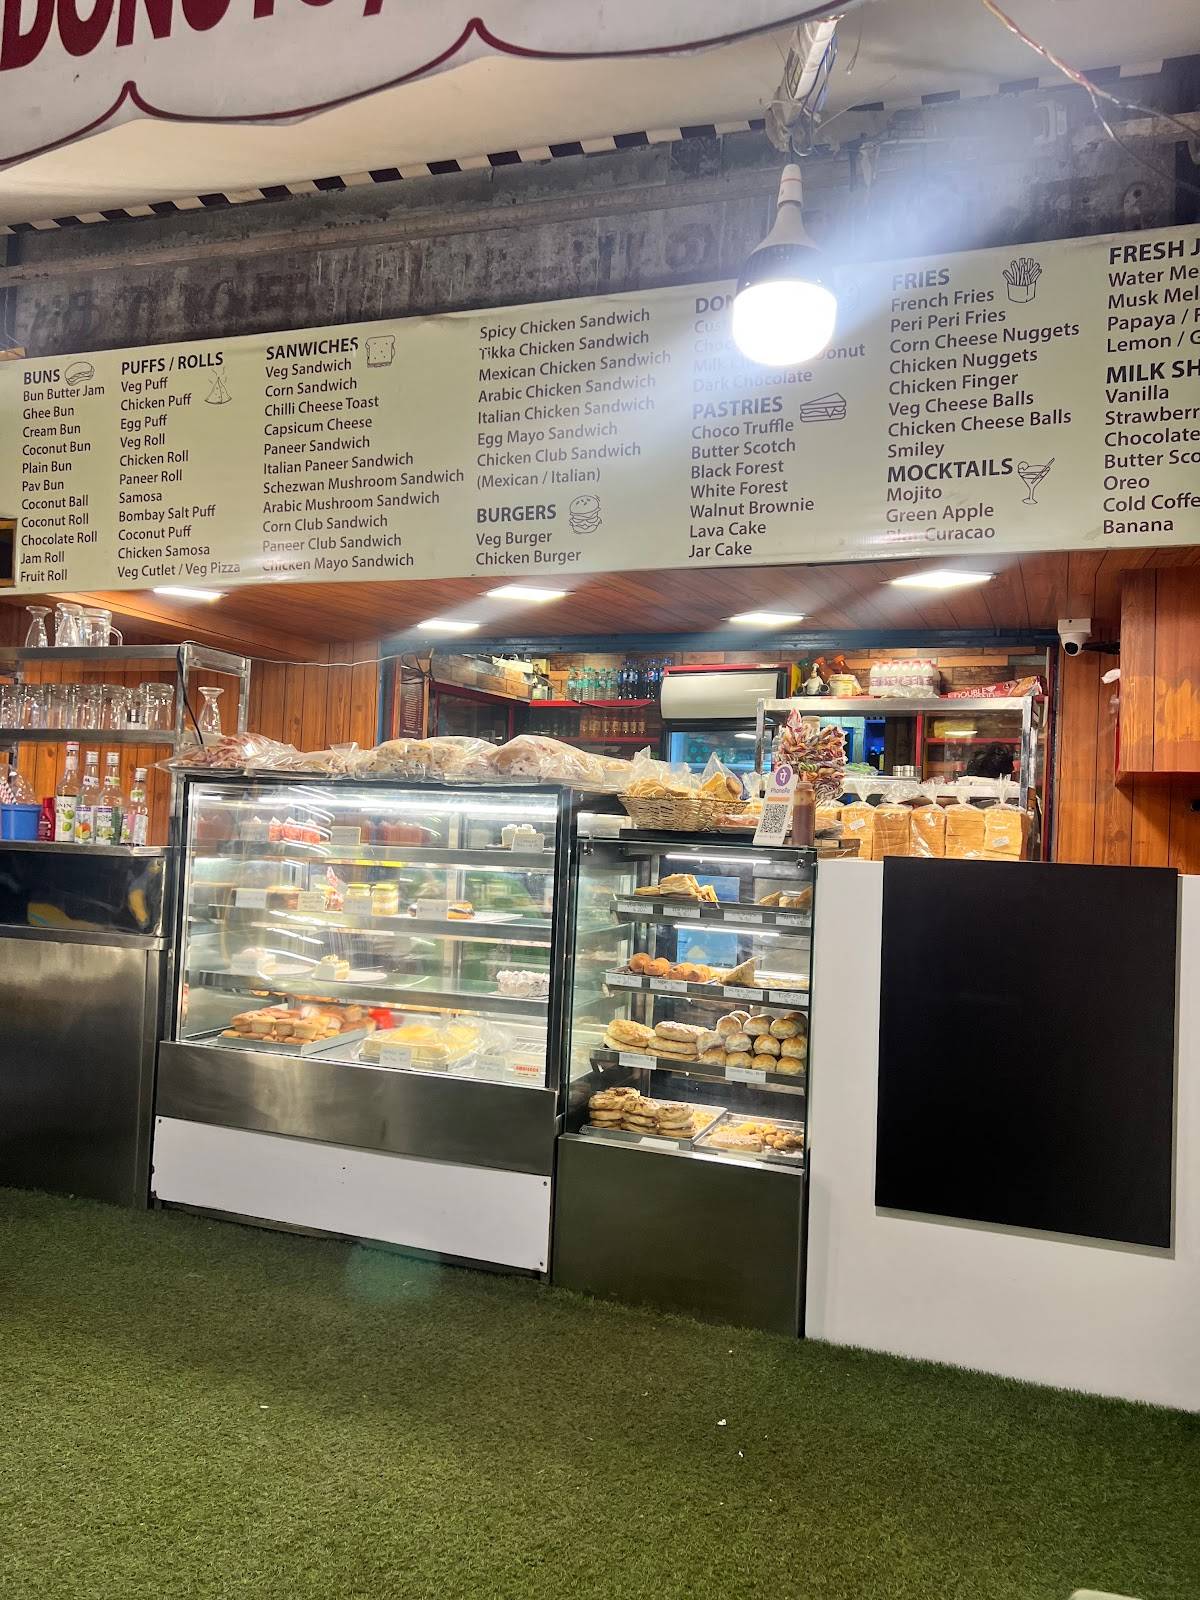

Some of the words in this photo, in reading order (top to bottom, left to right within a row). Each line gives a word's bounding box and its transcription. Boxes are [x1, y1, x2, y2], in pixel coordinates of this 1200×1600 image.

[1110, 240, 1184, 265] FRESH
[893, 268, 950, 290] FRIES
[1108, 271, 1164, 287] Water
[892, 292, 948, 312] French
[954, 289, 994, 305] Fries
[1108, 290, 1159, 309] Musk
[480, 325, 517, 342] Spicy
[520, 319, 575, 335] Chicken
[579, 308, 650, 329] Sandwich
[891, 316, 922, 333] Peri
[928, 312, 960, 329] Peri
[966, 309, 1006, 325] Fries
[1108, 314, 1175, 333] Papaya
[519, 340, 575, 356] Chicken
[579, 330, 649, 350] Sandwich
[890, 339, 930, 354] Corn
[935, 333, 998, 349] Cheese
[1003, 323, 1079, 344] Nuggets
[1107, 336, 1171, 353] Lemon
[266, 337, 358, 362] SANWICHES
[122, 358, 165, 375] PUFFS
[178, 352, 223, 370] ROLLS
[265, 366, 288, 380] Veg
[291, 357, 351, 376] Sandwich
[479, 366, 536, 382] Mexican
[539, 359, 596, 375] Chicken
[890, 356, 957, 374] Chicken
[963, 349, 1038, 369] Nuggets
[24, 369, 60, 385] BUNS
[1106, 362, 1166, 384] MILK
[23, 390, 44, 402] Bun
[47, 388, 80, 400] Butter
[82, 385, 105, 397] Jam
[121, 381, 142, 395] Veg
[145, 376, 168, 390] Puff
[265, 385, 294, 397] Corn
[297, 377, 357, 395] Sandwich
[478, 387, 522, 403] Arabic
[525, 382, 581, 399] Chicken
[889, 377, 957, 395] Chicken
[962, 373, 1018, 391] Finger
[121, 397, 165, 411] Chicken
[168, 393, 192, 407] Puff
[1105, 384, 1169, 404] Vanilla
[23, 407, 51, 420] Ghee
[53, 405, 74, 417] Bun
[265, 402, 295, 417] Chilli
[298, 400, 343, 414] Cheese
[345, 396, 379, 409] Toast
[478, 409, 520, 424] Italian
[524, 404, 580, 420] Chicken
[693, 396, 783, 419] PASTRIES
[888, 402, 920, 419] Veg
[925, 397, 988, 413] Cheese
[993, 390, 1034, 408] Balls
[23, 426, 57, 438] Cream
[60, 423, 81, 435] Bun
[121, 418, 141, 432] Egg
[144, 413, 168, 428] Puff
[264, 421, 323, 438] Capsicum
[327, 417, 372, 431] Cheese
[692, 425, 740, 440] Choco
[743, 418, 794, 435] Truffle
[888, 419, 956, 437] Chicken
[961, 416, 1024, 431] Cheese
[1030, 409, 1071, 426] Balls
[120, 436, 141, 450] Veg
[144, 433, 165, 446] Roll
[264, 443, 306, 455] Paneer
[309, 435, 370, 452] Sandwich
[478, 432, 503, 448] Egg
[507, 430, 545, 445] Mayo
[1104, 427, 1200, 447] Chocolate
[22, 443, 67, 456] Coconut
[70, 441, 91, 452] Bun
[477, 450, 532, 467] Chicken
[535, 447, 567, 463] Club
[692, 445, 740, 460] Butter
[743, 437, 795, 455] Scotch
[888, 441, 945, 459] Smiley
[22, 461, 48, 474] Plain
[51, 461, 72, 472] Bun
[120, 453, 164, 467] Chicken
[167, 450, 188, 463] Roll
[264, 461, 302, 475] Italian
[305, 459, 349, 472] Paneer
[352, 452, 413, 469] Sandwich
[1105, 453, 1164, 469] Butter
[119, 474, 159, 485] Paneer
[161, 469, 182, 482] Roll
[477, 473, 538, 490] (Mexican
[551, 467, 600, 484] Italian)
[691, 462, 732, 479] Black
[736, 460, 784, 476] Forest
[887, 458, 1013, 483] MOCKTAILS
[22, 481, 41, 492] Pav
[43, 479, 64, 491] Bun
[263, 481, 324, 494] Schezwan
[328, 475, 397, 490] Mushroom
[400, 469, 464, 485] Sandwich
[691, 483, 735, 499] White
[740, 480, 788, 495] Forest
[1104, 476, 1150, 490] Oreo
[22, 497, 66, 510] Coconut
[69, 494, 88, 507] Ball
[119, 492, 162, 504] Samosa
[263, 499, 302, 513] Arabic
[305, 497, 373, 511] Mushroom
[377, 490, 439, 507] Sandwich
[887, 485, 942, 504] Mojito
[1103, 495, 1145, 512] Cold
[119, 509, 165, 523] Bombay
[168, 506, 189, 519] Salt
[192, 504, 216, 518] Puff
[477, 504, 556, 523] BURGERS
[690, 503, 745, 518] Walnut
[749, 497, 814, 515] Brownie
[886, 509, 937, 523] Green
[942, 502, 994, 523] Apple
[21, 516, 66, 528] Coconut
[68, 513, 89, 525] Roll
[263, 520, 291, 533] Corn
[295, 517, 323, 531] Club
[326, 514, 387, 530] Sandwich
[690, 525, 724, 538] Lava
[729, 520, 766, 536] Cake
[1103, 520, 1173, 534] Banana
[21, 533, 74, 546] Chocolate
[77, 531, 97, 543] Roll
[118, 528, 165, 541] Coconut
[168, 524, 192, 538] Puff
[308, 536, 337, 550] Club
[340, 533, 401, 548] Sandwich
[476, 533, 501, 549] Veg
[505, 531, 552, 547] Burger
[20, 553, 42, 565] Jam
[44, 551, 64, 563] Roll
[118, 546, 162, 559] Chicken
[165, 545, 210, 557] Samosa
[476, 551, 529, 565] Chicken
[534, 550, 581, 565] Burger
[688, 544, 711, 558] Jar
[715, 541, 752, 556] Cake
[117, 566, 139, 580] Veg
[141, 564, 176, 576] Cutlet
[314, 557, 349, 572] Mayo
[352, 553, 414, 568] Sandwich
[20, 570, 45, 582] Fruit
[47, 569, 67, 581] Roll
